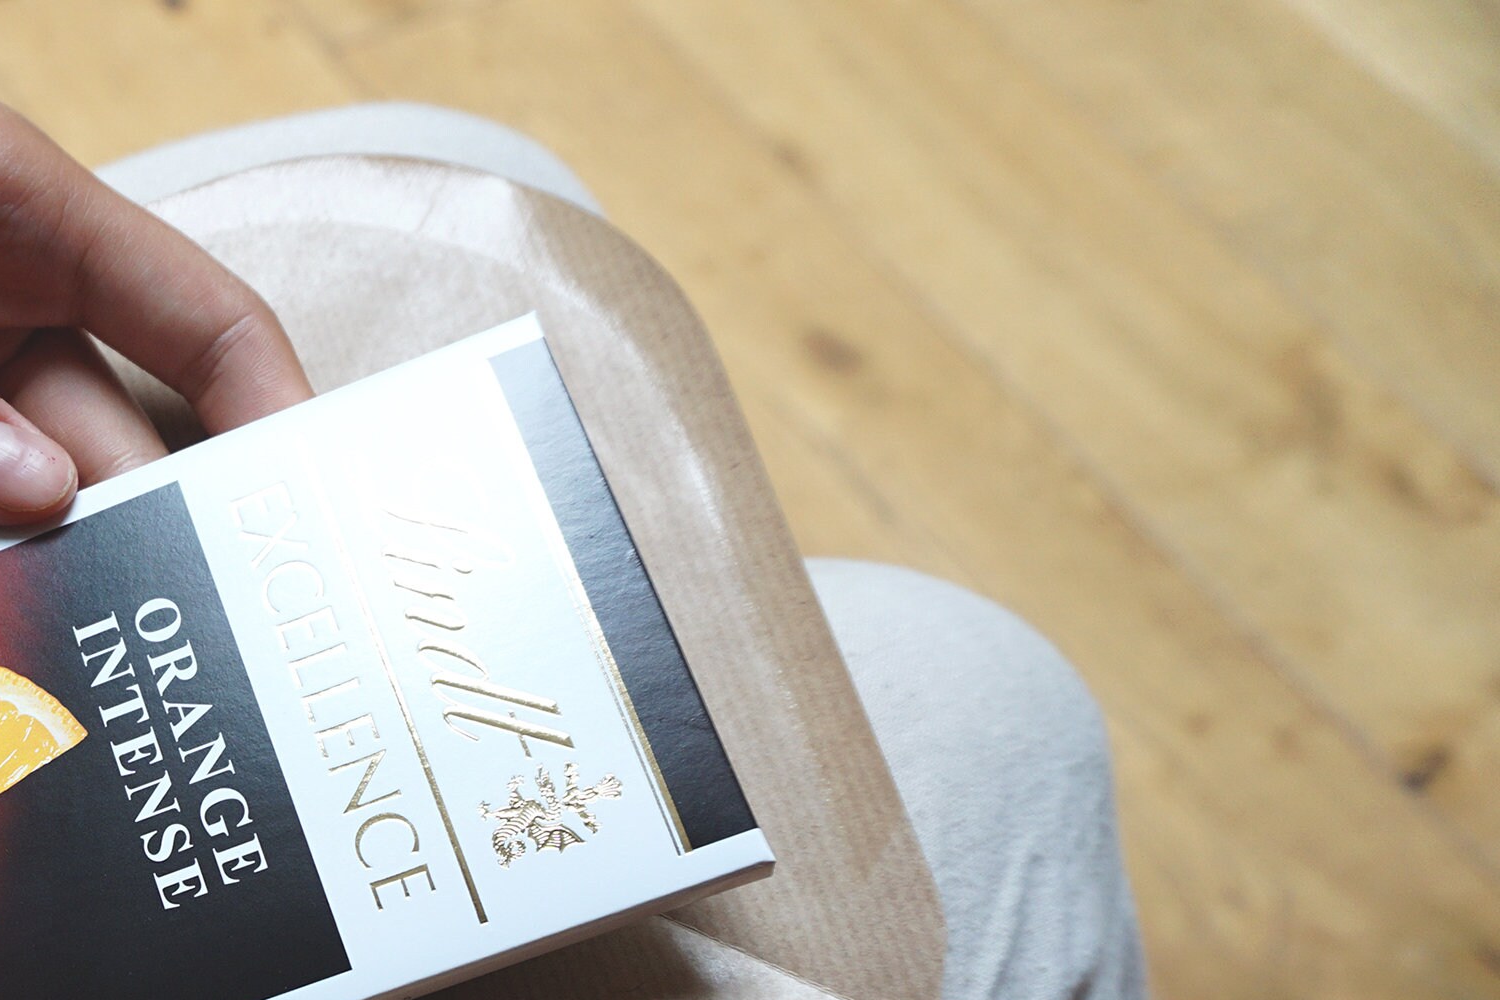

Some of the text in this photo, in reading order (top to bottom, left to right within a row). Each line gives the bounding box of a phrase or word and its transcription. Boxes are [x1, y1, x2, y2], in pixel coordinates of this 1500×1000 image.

[135, 597, 268, 885] ORANGE
[230, 480, 436, 911] EXCELLENCE
[341, 450, 576, 759] Lindt
[72, 610, 208, 910] INTENSE
